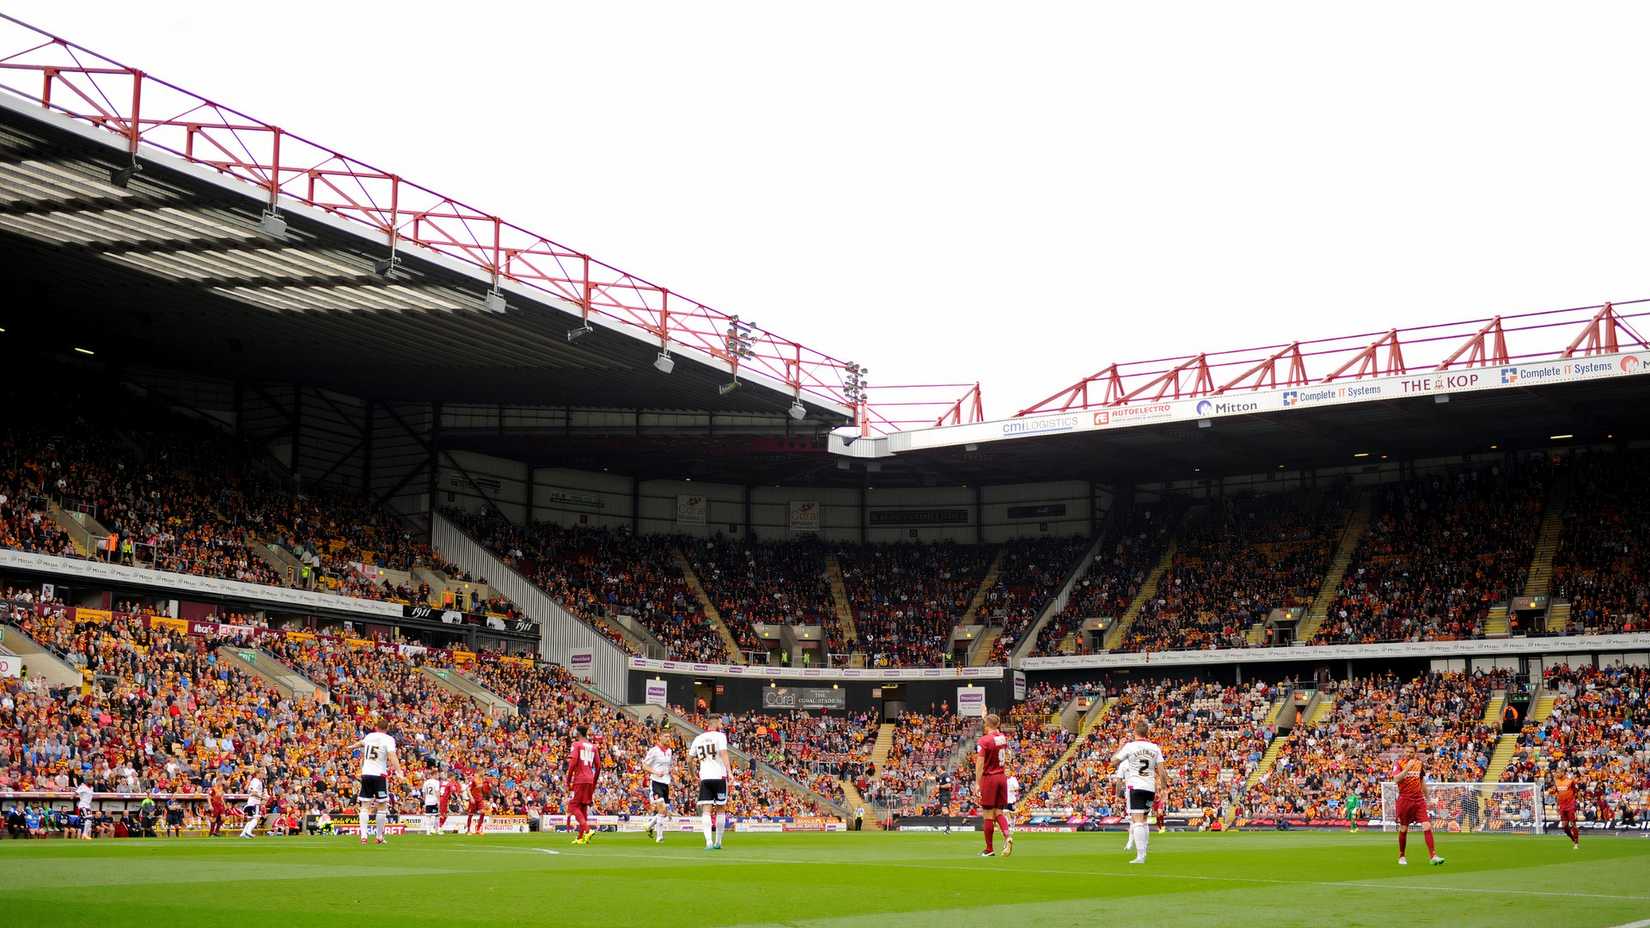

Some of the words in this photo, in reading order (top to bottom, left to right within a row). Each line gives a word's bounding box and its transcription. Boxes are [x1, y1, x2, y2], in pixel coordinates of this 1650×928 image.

[1520, 367, 1561, 380] Complete
[1564, 364, 1573, 375] IT
[1574, 362, 1612, 375] Systems
[1401, 379, 1431, 392] THE
[1447, 374, 1479, 388] KOP
[1300, 390, 1336, 402] Complete
[1338, 388, 1346, 398] IT
[1347, 385, 1381, 398] Systems
[1215, 402, 1258, 414] Mitton
[411, 607, 432, 618] 1911
[515, 621, 533, 633] 1911
[365, 744, 379, 760] 15
[698, 744, 717, 760] 34
[1138, 759, 1150, 776] 2
[426, 786, 433, 795] 12
